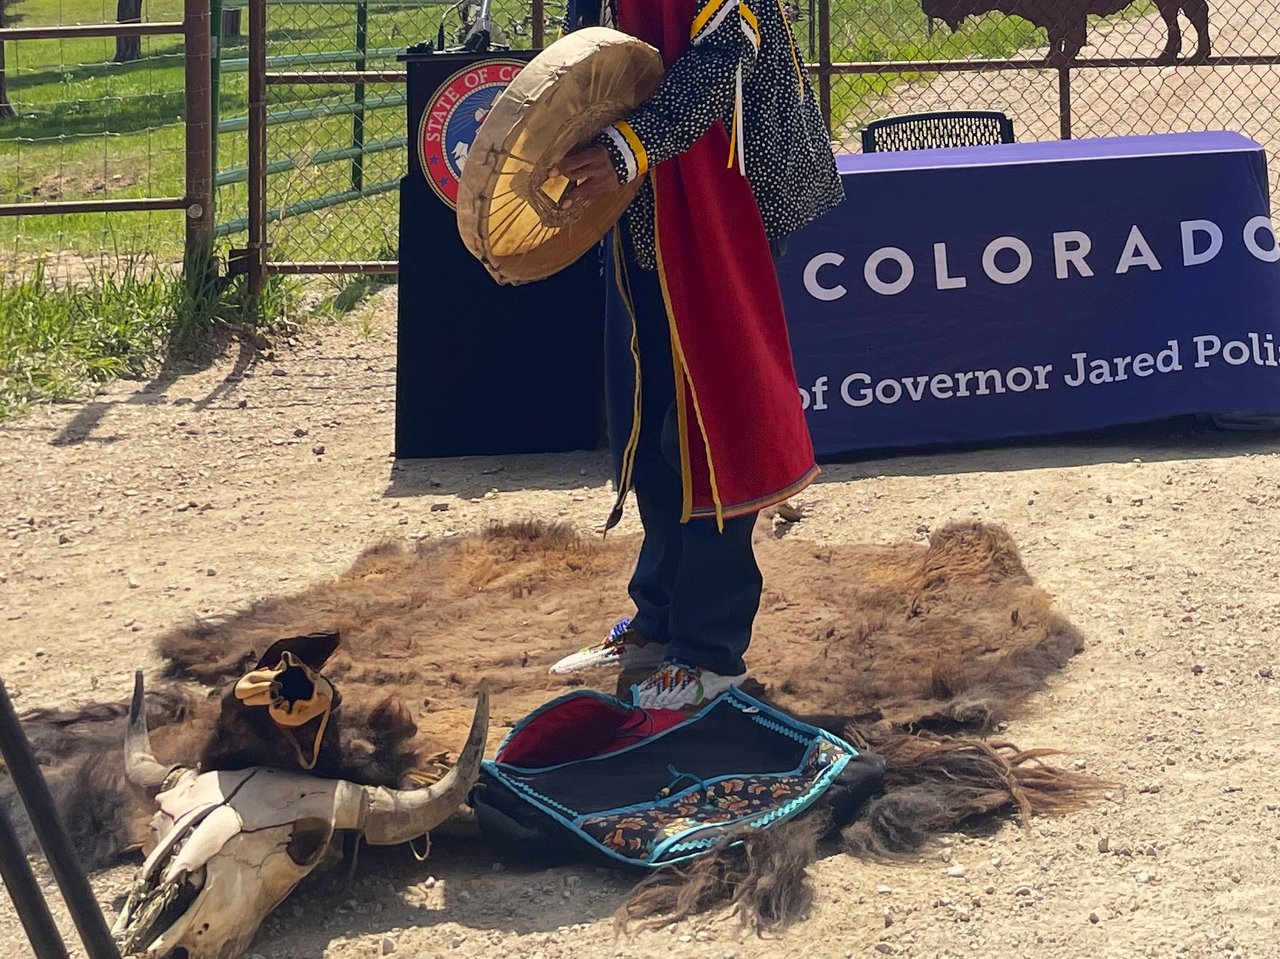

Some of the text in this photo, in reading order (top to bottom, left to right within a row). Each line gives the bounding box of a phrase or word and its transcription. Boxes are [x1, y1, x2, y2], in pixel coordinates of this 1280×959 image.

[426, 87, 461, 142] STATE
[464, 68, 489, 88] OF
[802, 215, 1280, 301] COLORADO
[840, 364, 1053, 407] Governor
[1064, 341, 1182, 388] Jared
